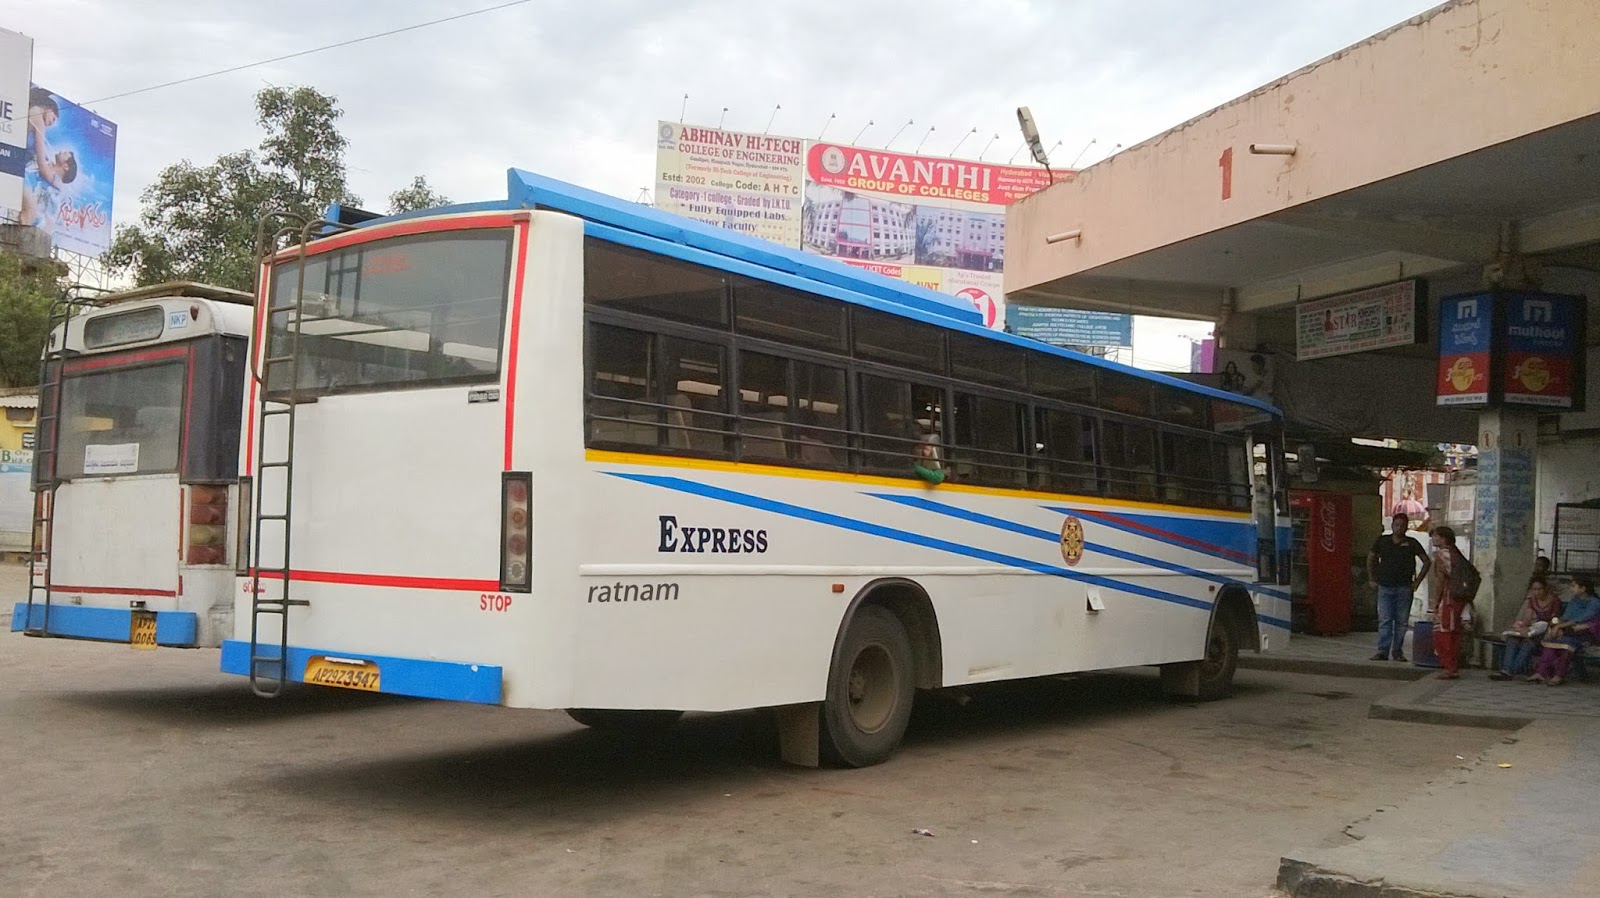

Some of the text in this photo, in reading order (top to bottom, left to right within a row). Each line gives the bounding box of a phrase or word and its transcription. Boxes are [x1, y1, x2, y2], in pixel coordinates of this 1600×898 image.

[679, 127, 743, 148] ABHINAV
[746, 135, 800, 155] HI-TECH
[679, 143, 720, 158] COLLEGE
[722, 149, 735, 159] OF
[736, 150, 800, 166] ENGINEERING
[662, 172, 683, 182] Estd:
[685, 174, 706, 185] 2002
[710, 180, 734, 189] College
[735, 179, 761, 191] Code:
[848, 153, 991, 191] AVANTHI
[1219, 146, 1233, 201] 1
[669, 187, 700, 202] Category
[707, 192, 733, 205] college
[736, 194, 761, 207] Graded
[848, 177, 990, 202] GROUP OF COLLEGES
[689, 203, 712, 215] Fully
[715, 206, 761, 219] Equipped
[722, 220, 757, 232] Faculty
[883, 265, 902, 276] Codes
[170, 313, 187, 326] NKP
[480, 594, 512, 612] STOP
[312, 667, 379, 688] AP29Z3547
